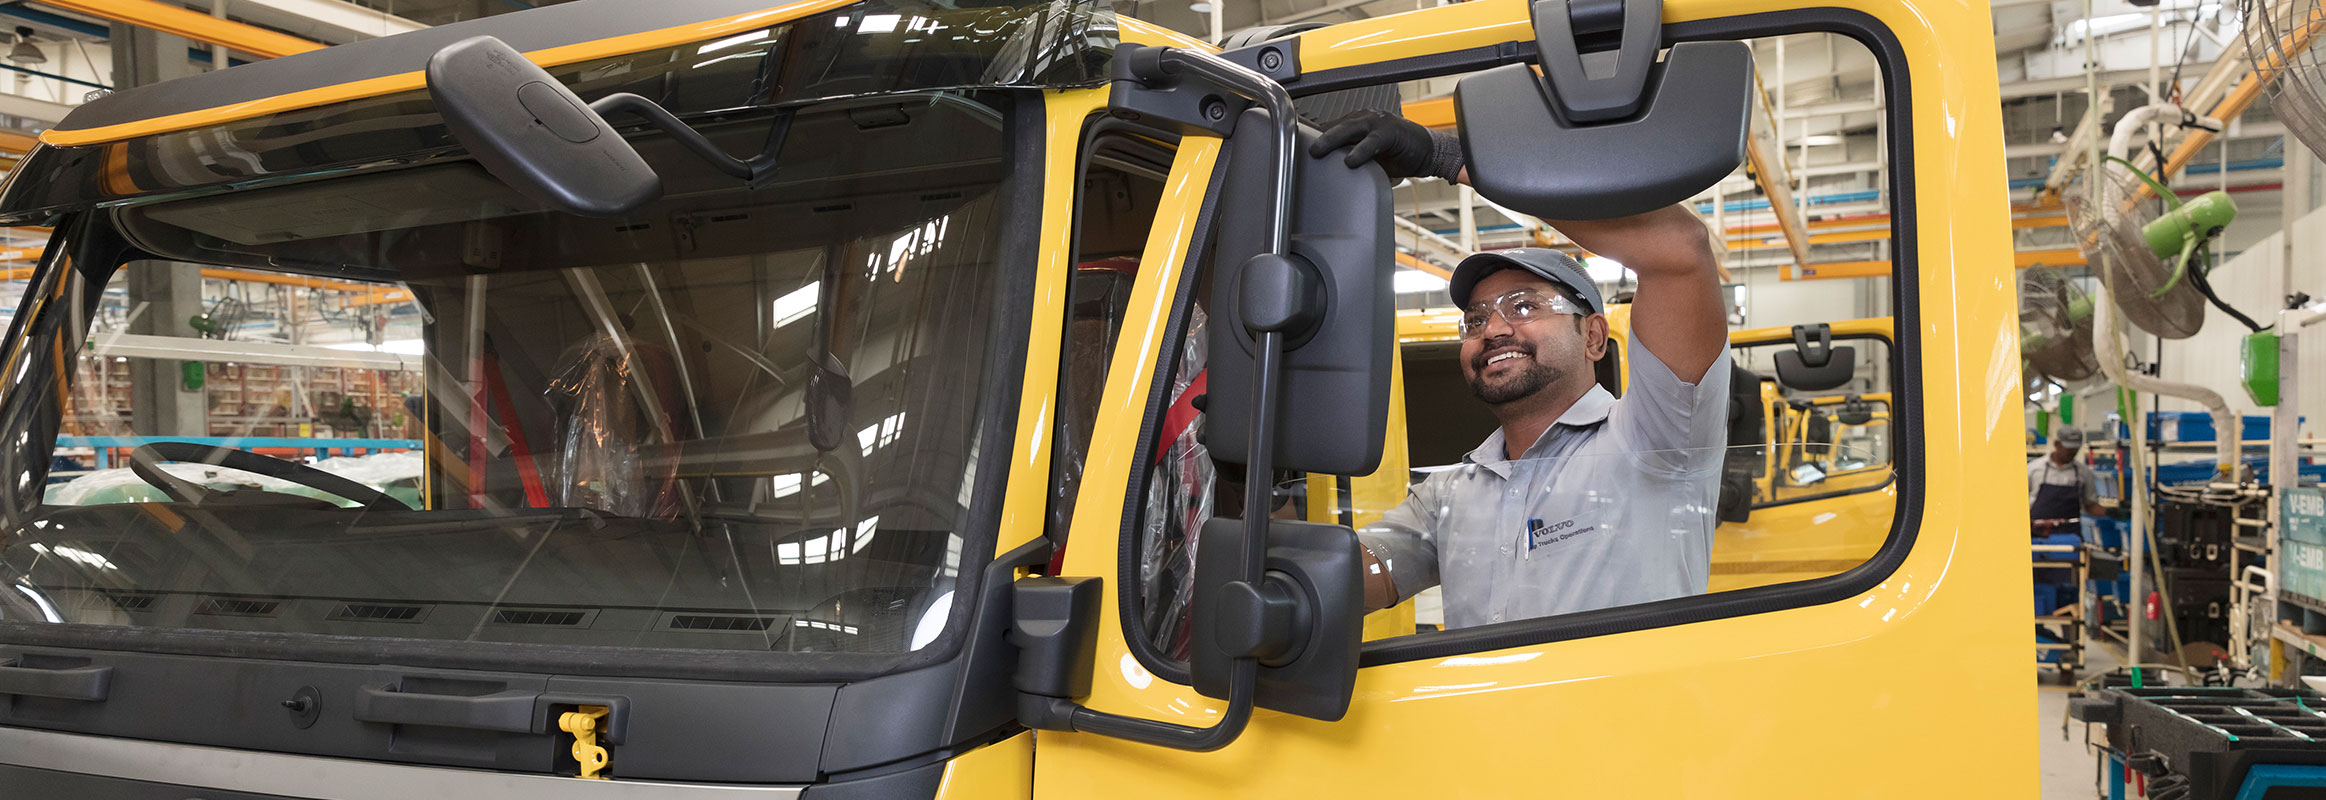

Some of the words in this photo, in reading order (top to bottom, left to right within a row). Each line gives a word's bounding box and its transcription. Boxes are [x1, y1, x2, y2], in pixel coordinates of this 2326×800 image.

[2289, 494, 2325, 517] V-EMB
[1533, 520, 1574, 538] VOLVO
[1538, 537, 1559, 547] Trucks
[1560, 526, 1594, 540] Operations
